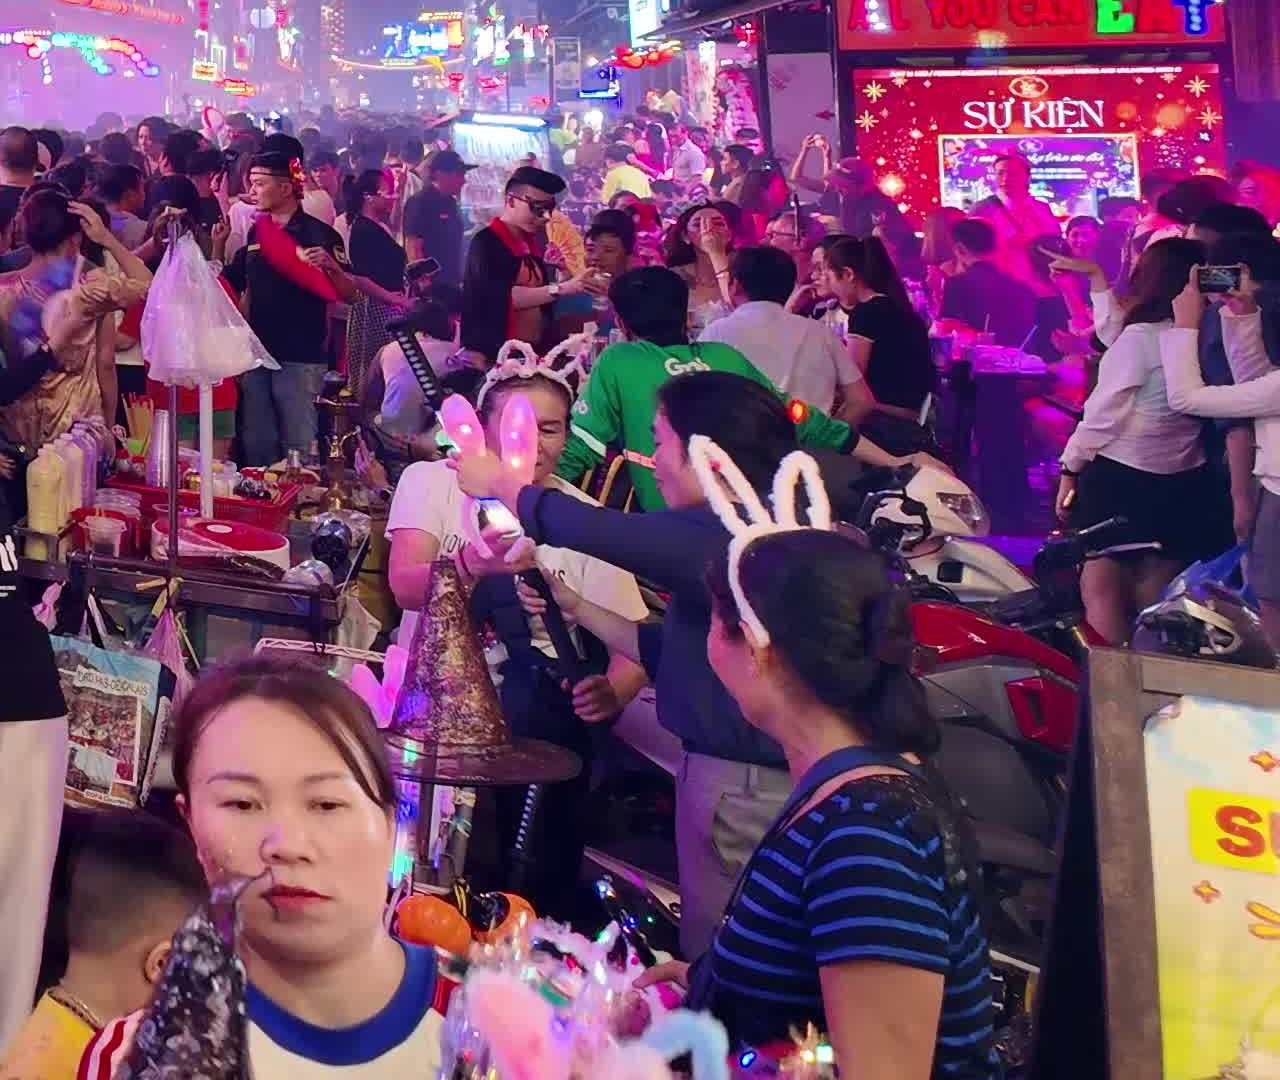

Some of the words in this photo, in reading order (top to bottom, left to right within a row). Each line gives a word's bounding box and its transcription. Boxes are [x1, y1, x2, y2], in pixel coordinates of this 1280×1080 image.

[962, 96, 1016, 134] SỰ
[1023, 96, 1104, 134] KIỆN
[1215, 804, 1280, 858] S
